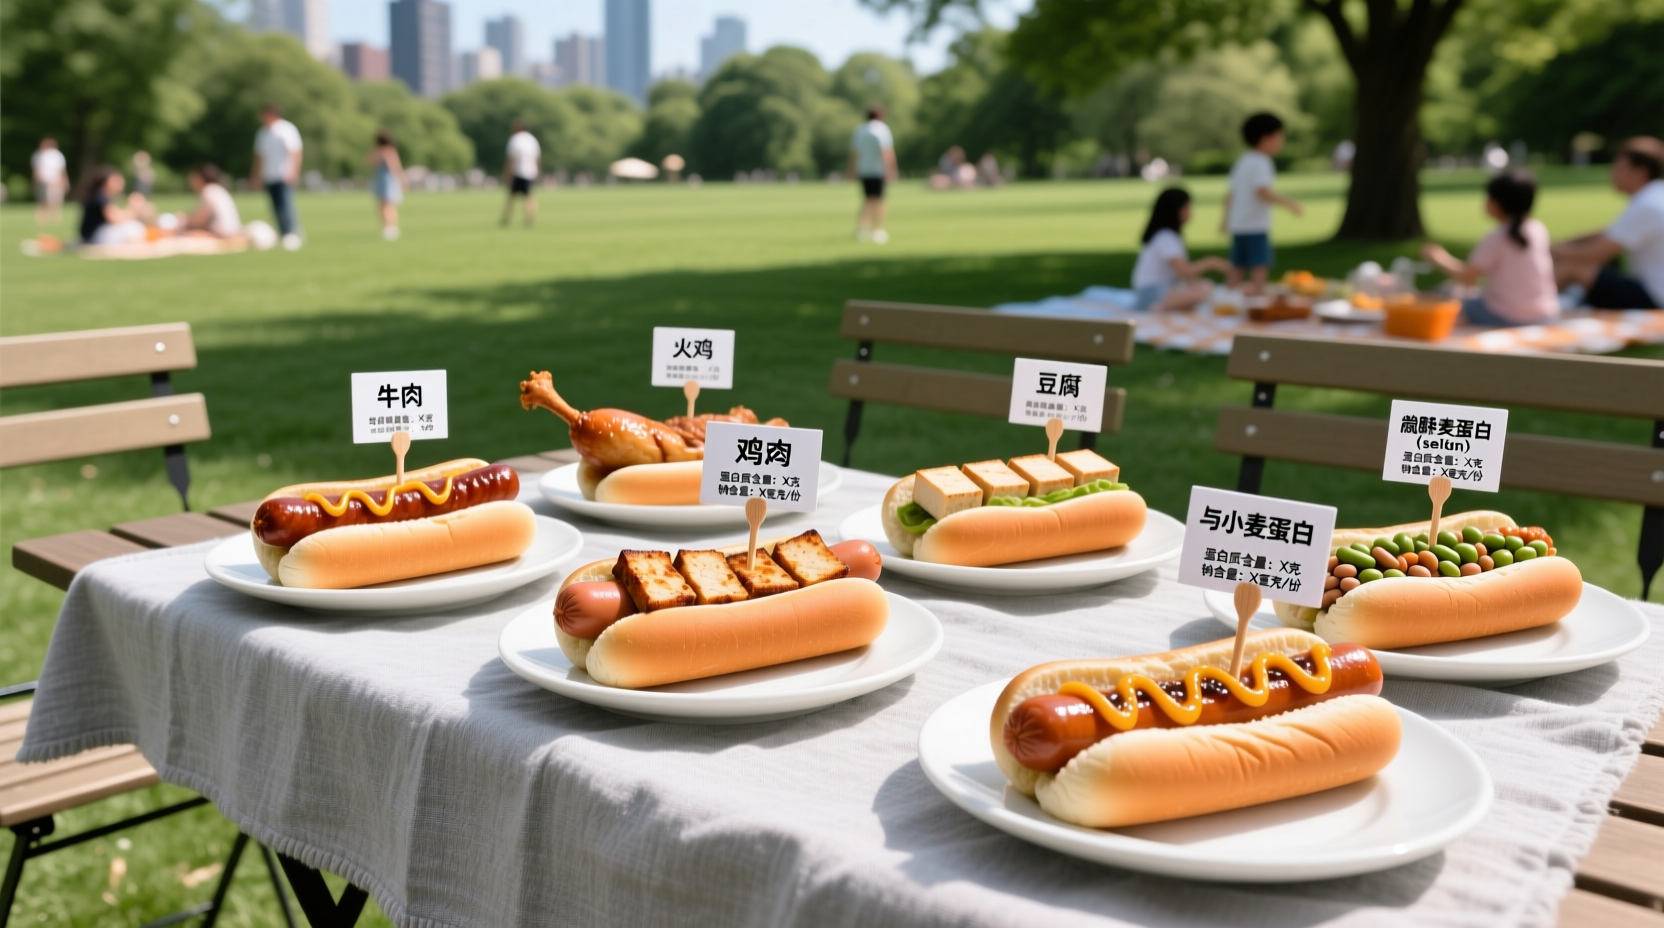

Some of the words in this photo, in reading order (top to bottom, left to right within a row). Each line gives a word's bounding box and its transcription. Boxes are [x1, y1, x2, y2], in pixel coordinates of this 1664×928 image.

[673, 338, 712, 360] 火鸡
[377, 382, 422, 409] 牛肉
[1036, 372, 1082, 398] 豆腐
[735, 436, 791, 467] 鸡肉
[1199, 505, 1314, 546] 与小麦蛋白
